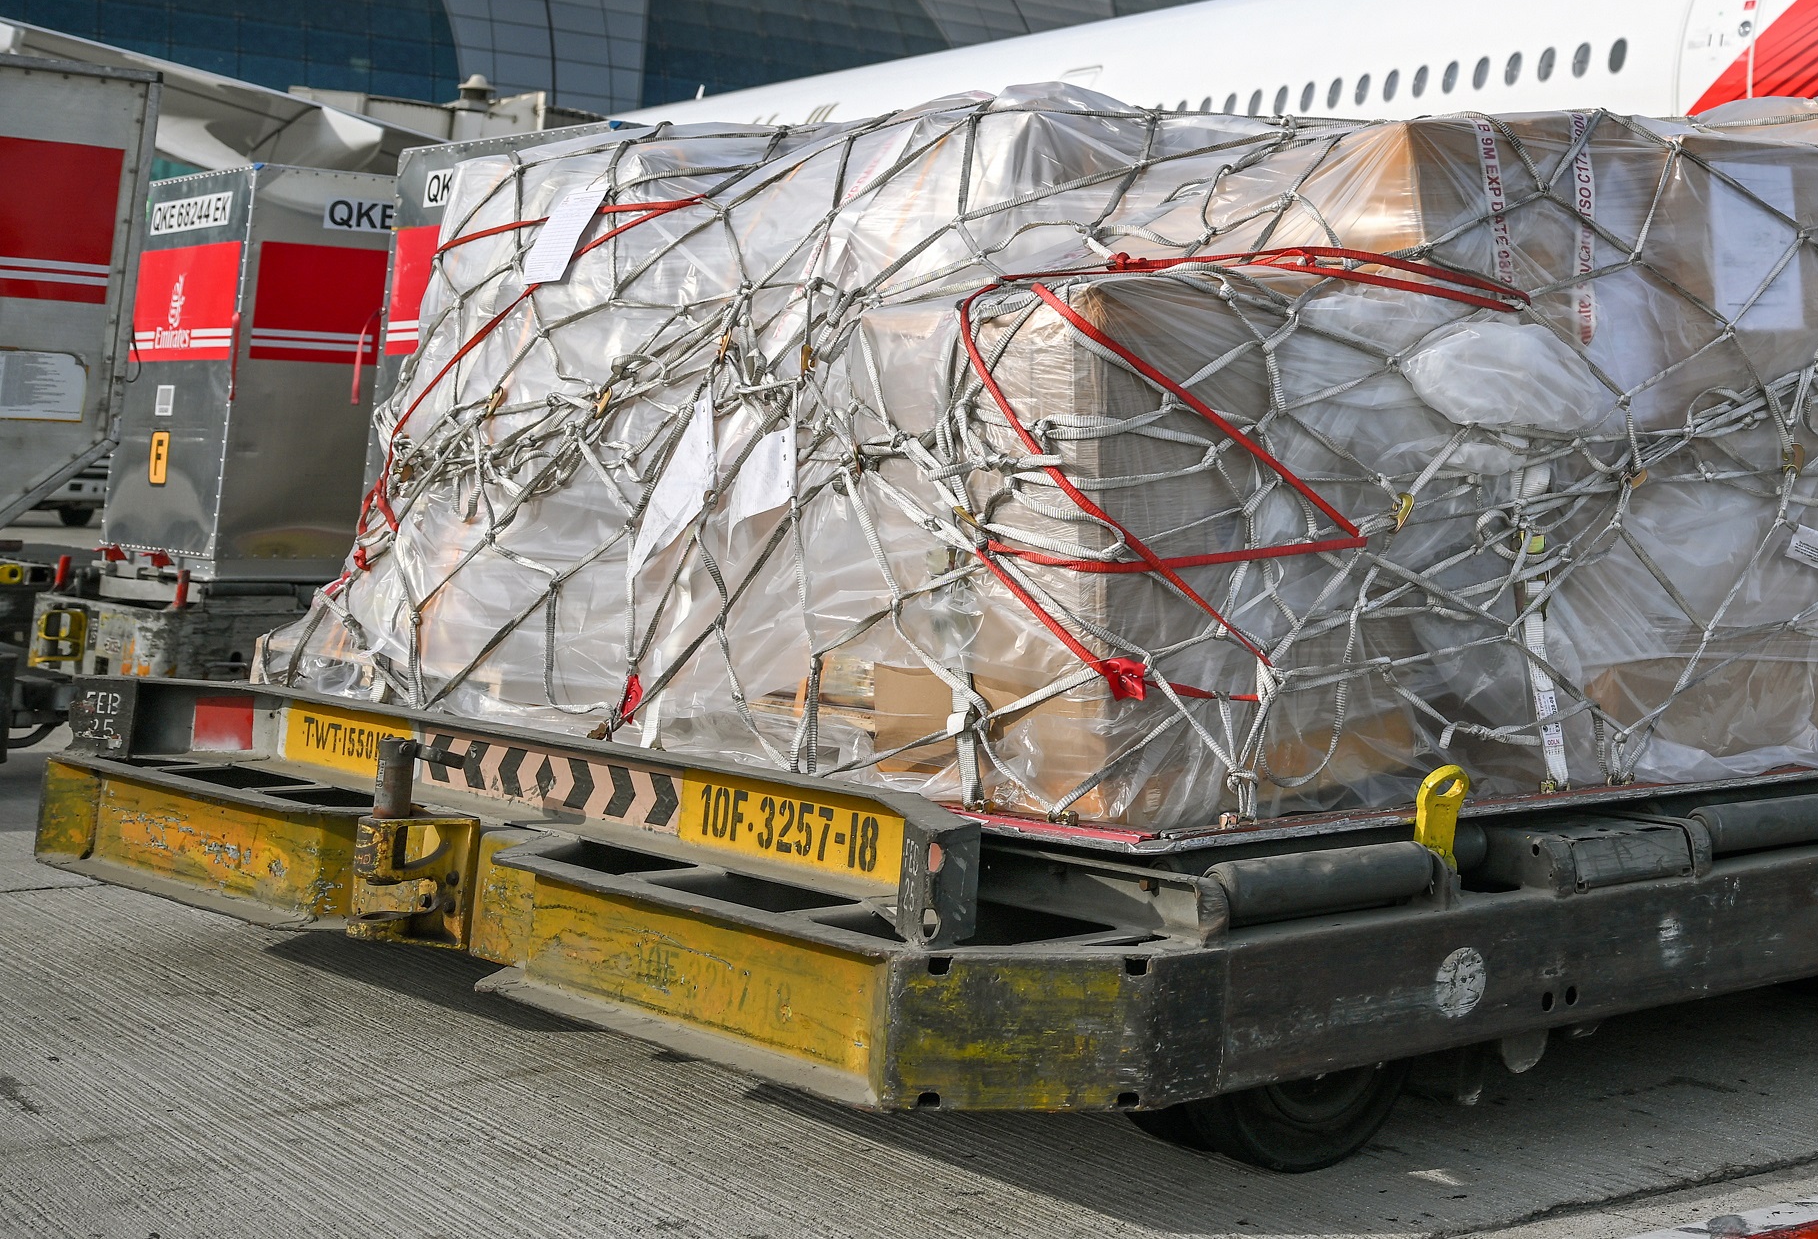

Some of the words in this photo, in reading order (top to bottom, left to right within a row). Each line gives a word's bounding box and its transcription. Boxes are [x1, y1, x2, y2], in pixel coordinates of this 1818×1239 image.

[1481, 138, 1496, 160] 9M
[1486, 164, 1502, 197] EXP
[153, 205, 176, 231] QKE
[177, 199, 211, 228] 68244
[213, 196, 230, 223] EK
[154, 326, 191, 350] Emirates
[153, 439, 164, 476] F
[902, 837, 920, 877] FEB
[903, 877, 915, 911] 25
